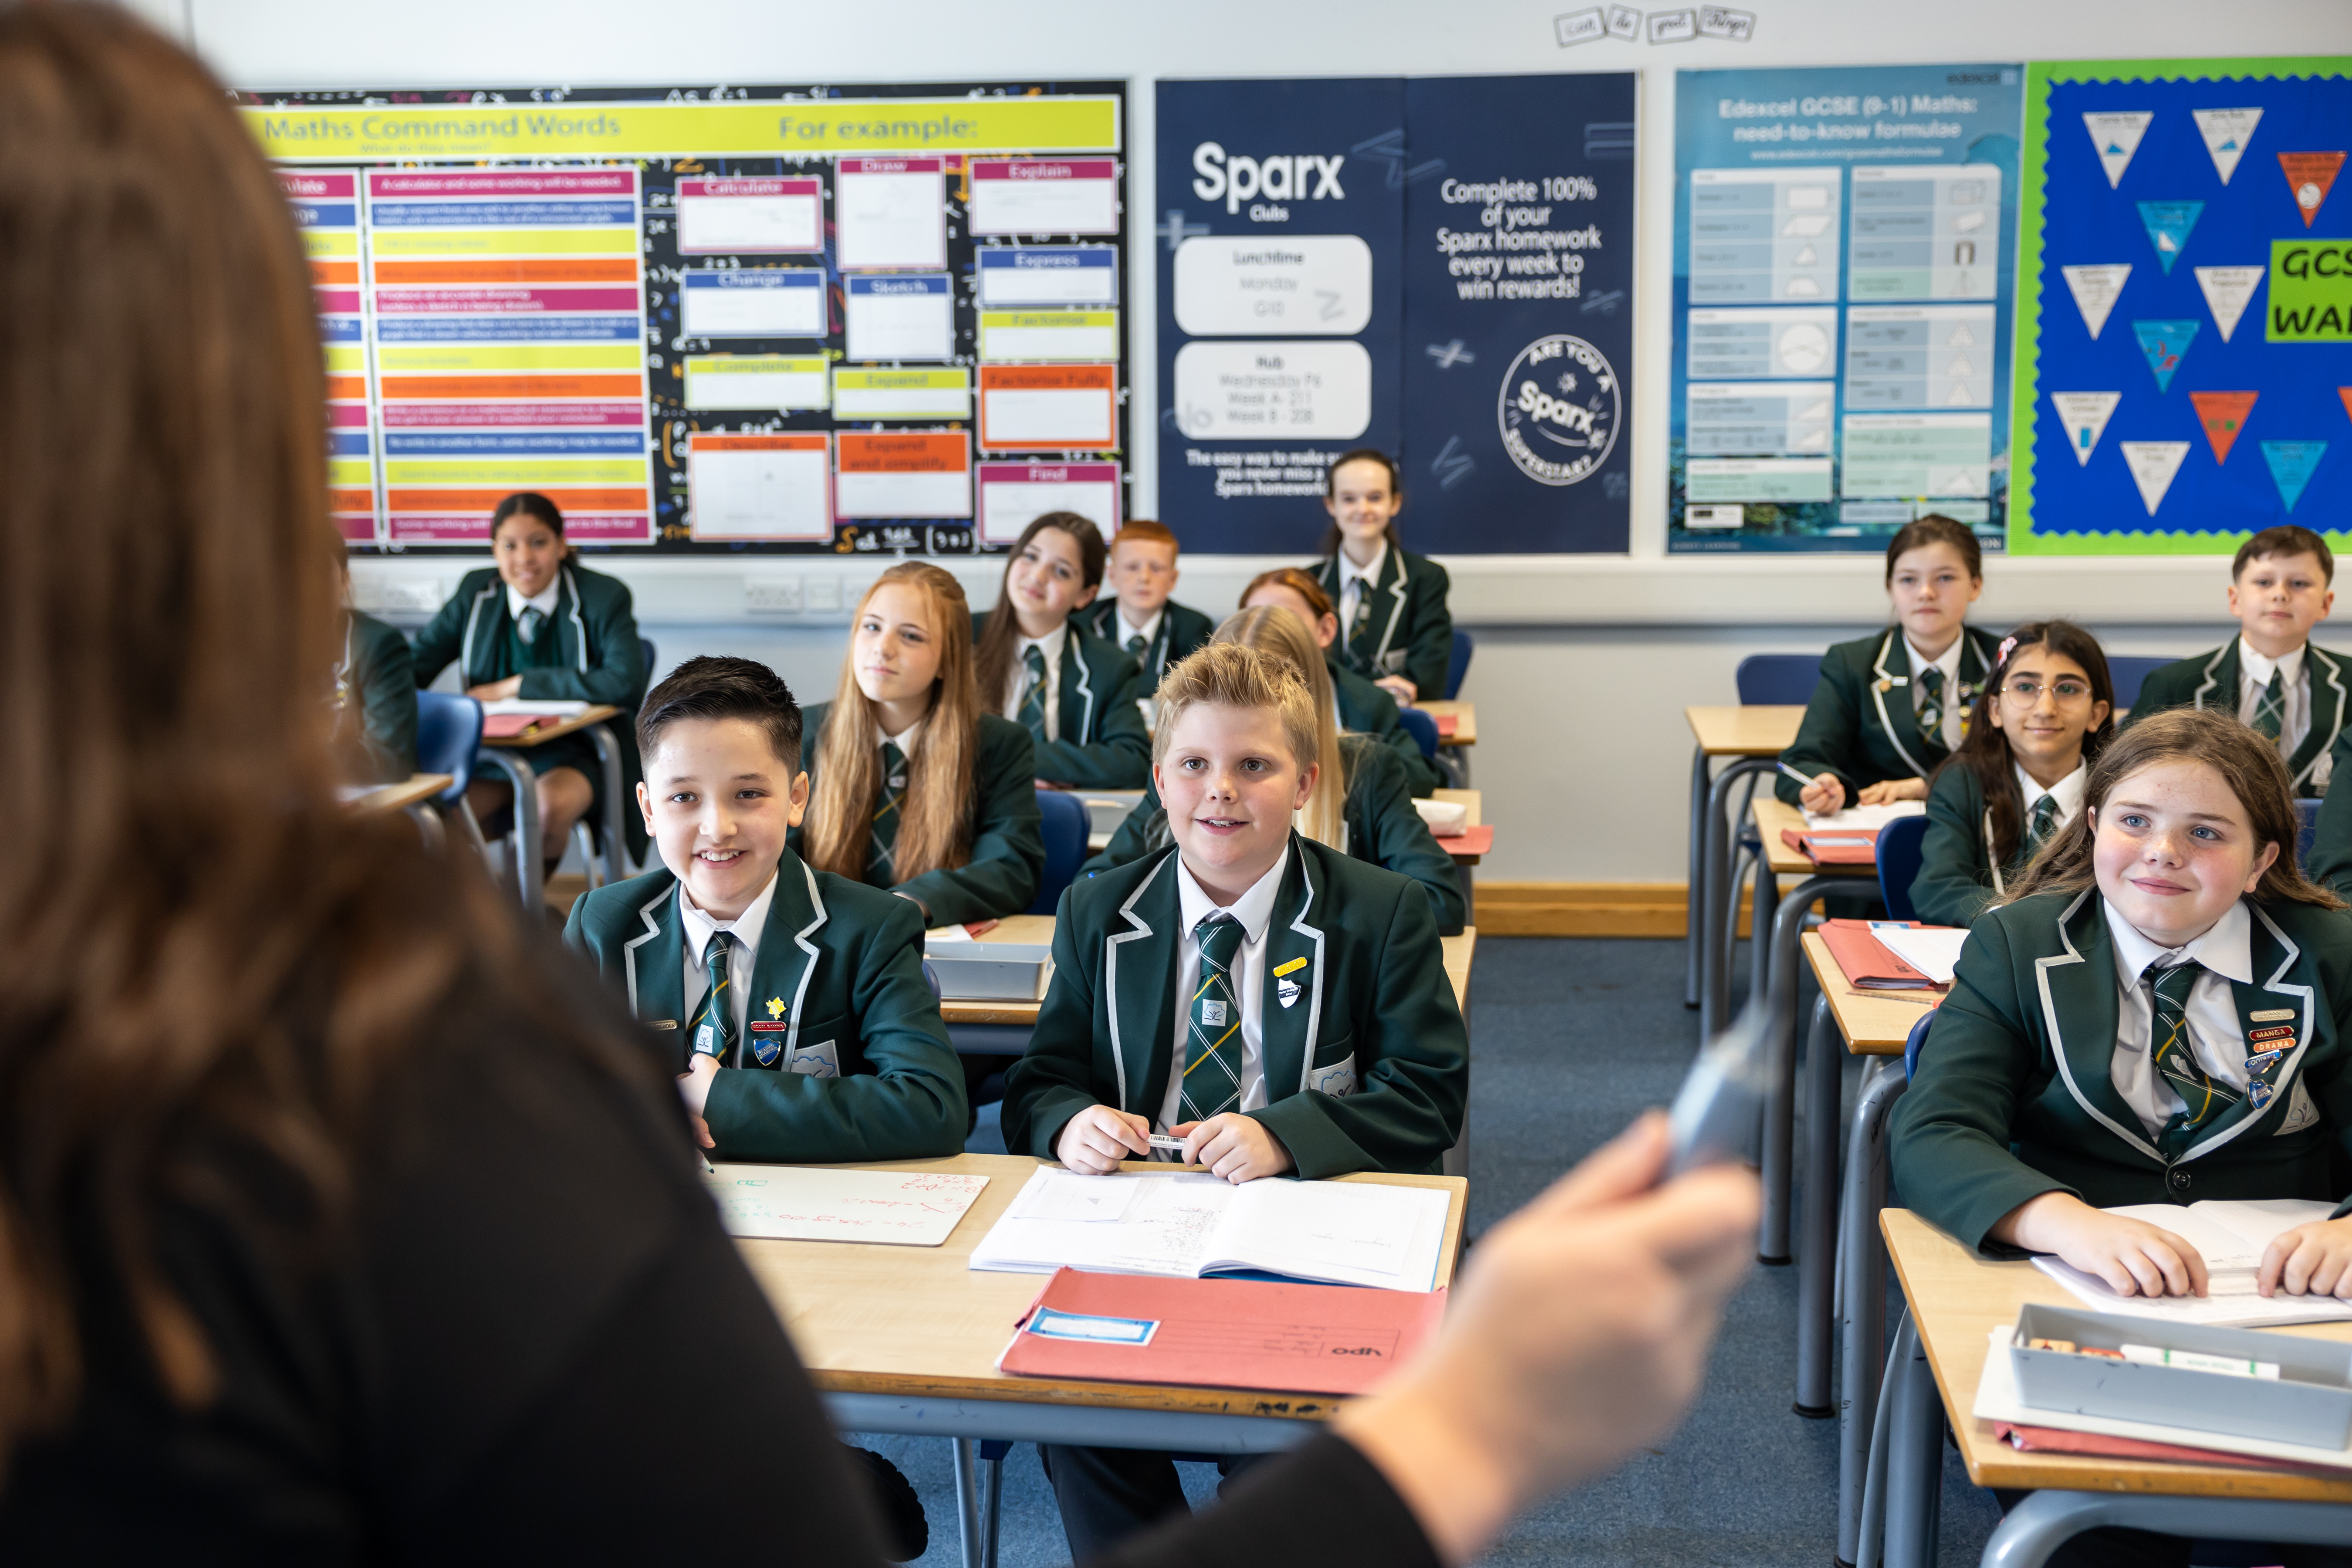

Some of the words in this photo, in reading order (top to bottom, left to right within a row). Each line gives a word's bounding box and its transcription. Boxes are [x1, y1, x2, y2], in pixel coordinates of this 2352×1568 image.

[1719, 100, 1797, 118] Edexcel
[1801, 97, 1859, 117] GCSE
[1863, 95, 1907, 117] (9-1)
[1911, 94, 1978, 114] Maths:
[264, 115, 354, 140] Maths
[362, 114, 518, 140] Command
[525, 112, 622, 137] Words
[780, 117, 826, 140] For
[837, 114, 979, 144] example:
[1734, 123, 1871, 142] need-to-know
[1875, 120, 1962, 139] formulae
[861, 159, 908, 173] Draw
[1009, 163, 1072, 179] Explain
[1192, 141, 1346, 215] Sparx
[704, 180, 784, 196] Calculate
[1440, 176, 1539, 207] Complete
[1542, 176, 1598, 202] 100%
[1480, 201, 1505, 227] of
[1505, 206, 1552, 232] your
[1436, 227, 1494, 257] Sparx
[1495, 223, 1603, 251] homework
[1014, 253, 1079, 269] Express
[1232, 250, 1305, 266] Lunchtime
[1448, 255, 1504, 281] every
[1506, 250, 1560, 275] week
[1561, 251, 1585, 274] to
[718, 273, 785, 289] Change
[871, 279, 928, 296] Sketch
[1456, 276, 1494, 300] win
[1497, 273, 1581, 300] rewards!
[2274, 304, 2352, 336] WA
[713, 359, 794, 374] Complete
[1529, 341, 1564, 367] ARE
[1565, 341, 1602, 374] YOU
[1596, 375, 1612, 393] A
[866, 372, 929, 389] Expand
[1218, 373, 1300, 389] Wednesday
[1227, 391, 1265, 406] Week
[1225, 409, 1265, 424] Week
[1517, 380, 1597, 436] Sparx
[865, 437, 926, 454] Expand
[1506, 427, 1593, 479] SUPERSTAR?
[1186, 448, 1212, 466] The
[1213, 452, 1242, 469] easy
[1244, 452, 1271, 469] way
[1272, 449, 1288, 466] to
[1290, 448, 1325, 466] make
[1028, 466, 1068, 482] Find
[1217, 467, 1242, 482] you
[1246, 467, 1282, 481] never
[1284, 466, 1314, 480] miss
[1215, 479, 1254, 500] Sparx
[2256, 1029, 2286, 1038] MANGA
[2259, 1040, 2289, 1051] DRAMA
